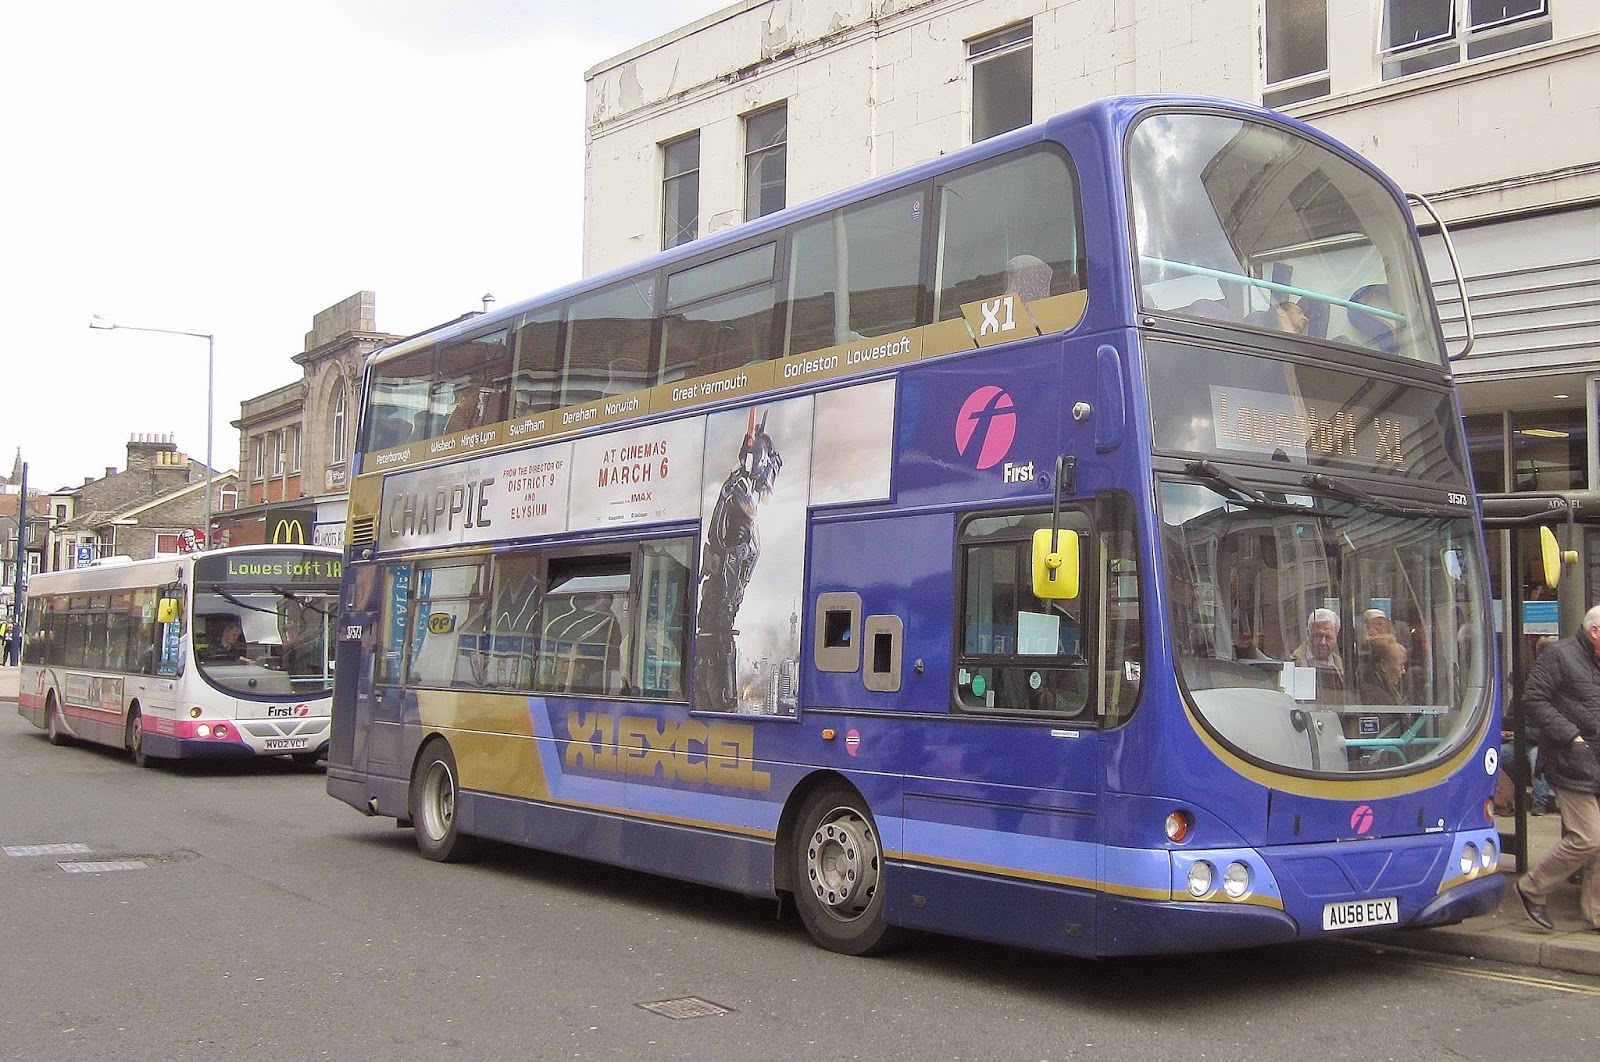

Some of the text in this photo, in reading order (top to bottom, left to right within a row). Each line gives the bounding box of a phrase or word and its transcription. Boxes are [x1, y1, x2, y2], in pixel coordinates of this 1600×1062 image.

[980, 296, 1016, 336] X1
[376, 336, 911, 465] Peterborough Wisbech King's Lynn Swaffham Dereham Norwich Great Yarmouth Gorleston Lowestoft
[1221, 392, 1404, 464] Lowestoft X1
[603, 440, 667, 464] AT CINEMAS
[503, 460, 563, 478] FROM THE DIRECTOR OF
[598, 457, 669, 487] MARCH 6
[1003, 461, 1034, 483] First
[508, 473, 556, 492] DISTRICT 9
[524, 492, 536, 502] AND
[630, 492, 652, 503] IMAX
[1447, 493, 1467, 506] 37573
[1548, 500, 1582, 509] ADSEL
[389, 477, 495, 539] CHAPPIE
[511, 503, 548, 520] ELYSIUM
[228, 560, 342, 577] Lowestoft 1A
[346, 625, 363, 639] 37573
[268, 706, 293, 717] First
[266, 739, 306, 749] MV02 VCT
[1330, 901, 1392, 926] AU58 ECX
